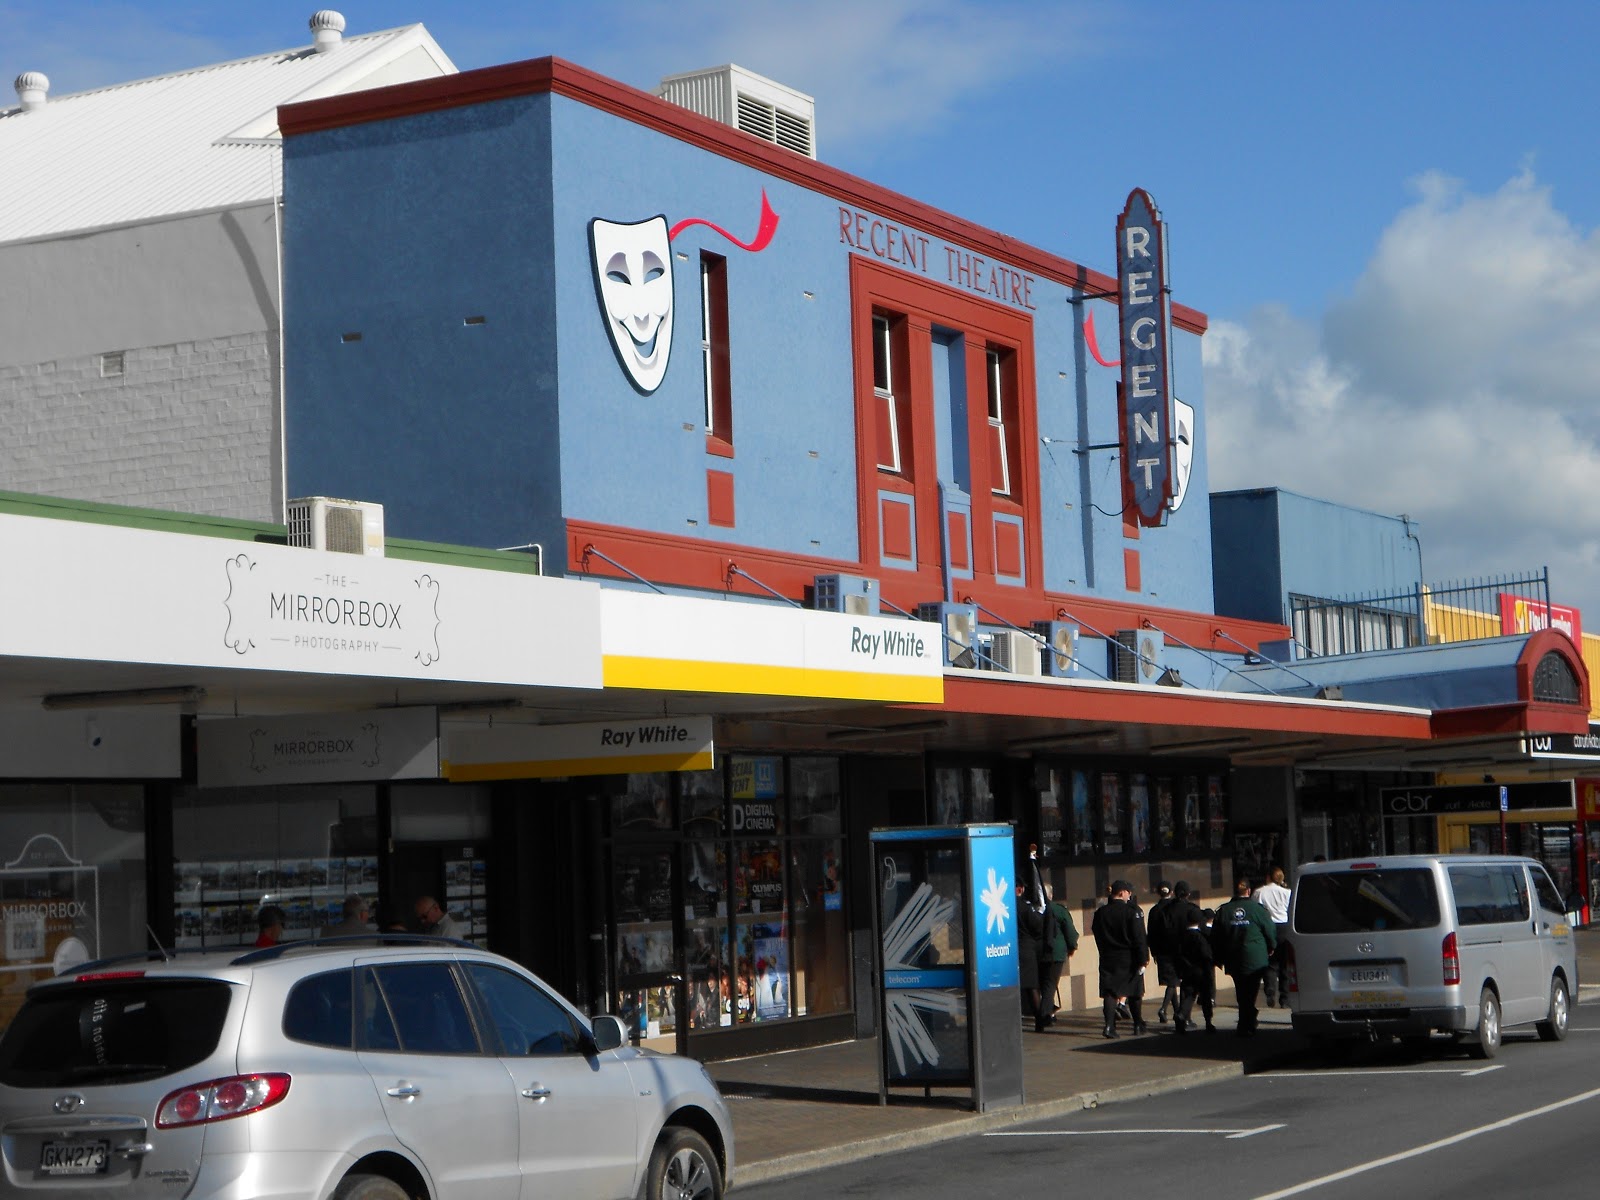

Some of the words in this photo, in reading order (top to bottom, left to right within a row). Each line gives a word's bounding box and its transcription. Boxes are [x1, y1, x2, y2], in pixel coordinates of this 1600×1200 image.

[944, 246, 1037, 310] THEATRE
[1126, 226, 1160, 490] REGENT
[325, 574, 347, 588] THE
[270, 592, 402, 630] MIRRORBOX
[294, 635, 379, 653] PHOTOGRAPHY
[851, 626, 881, 660] Ray
[884, 630, 924, 658] White
[601, 728, 635, 748] Ray
[639, 725, 688, 743] White
[273, 740, 355, 756] MIRRORBOX
[745, 804, 775, 816] DIGITAL
[1390, 791, 1433, 813] cbr
[745, 817, 776, 830] CINEMA
[752, 883, 782, 894] OLYMPUS
[2, 901, 88, 921] MIRRORBOX
[985, 943, 1011, 958] telecom
[888, 974, 920, 984] telecom
[44, 1146, 105, 1167] GKW273
